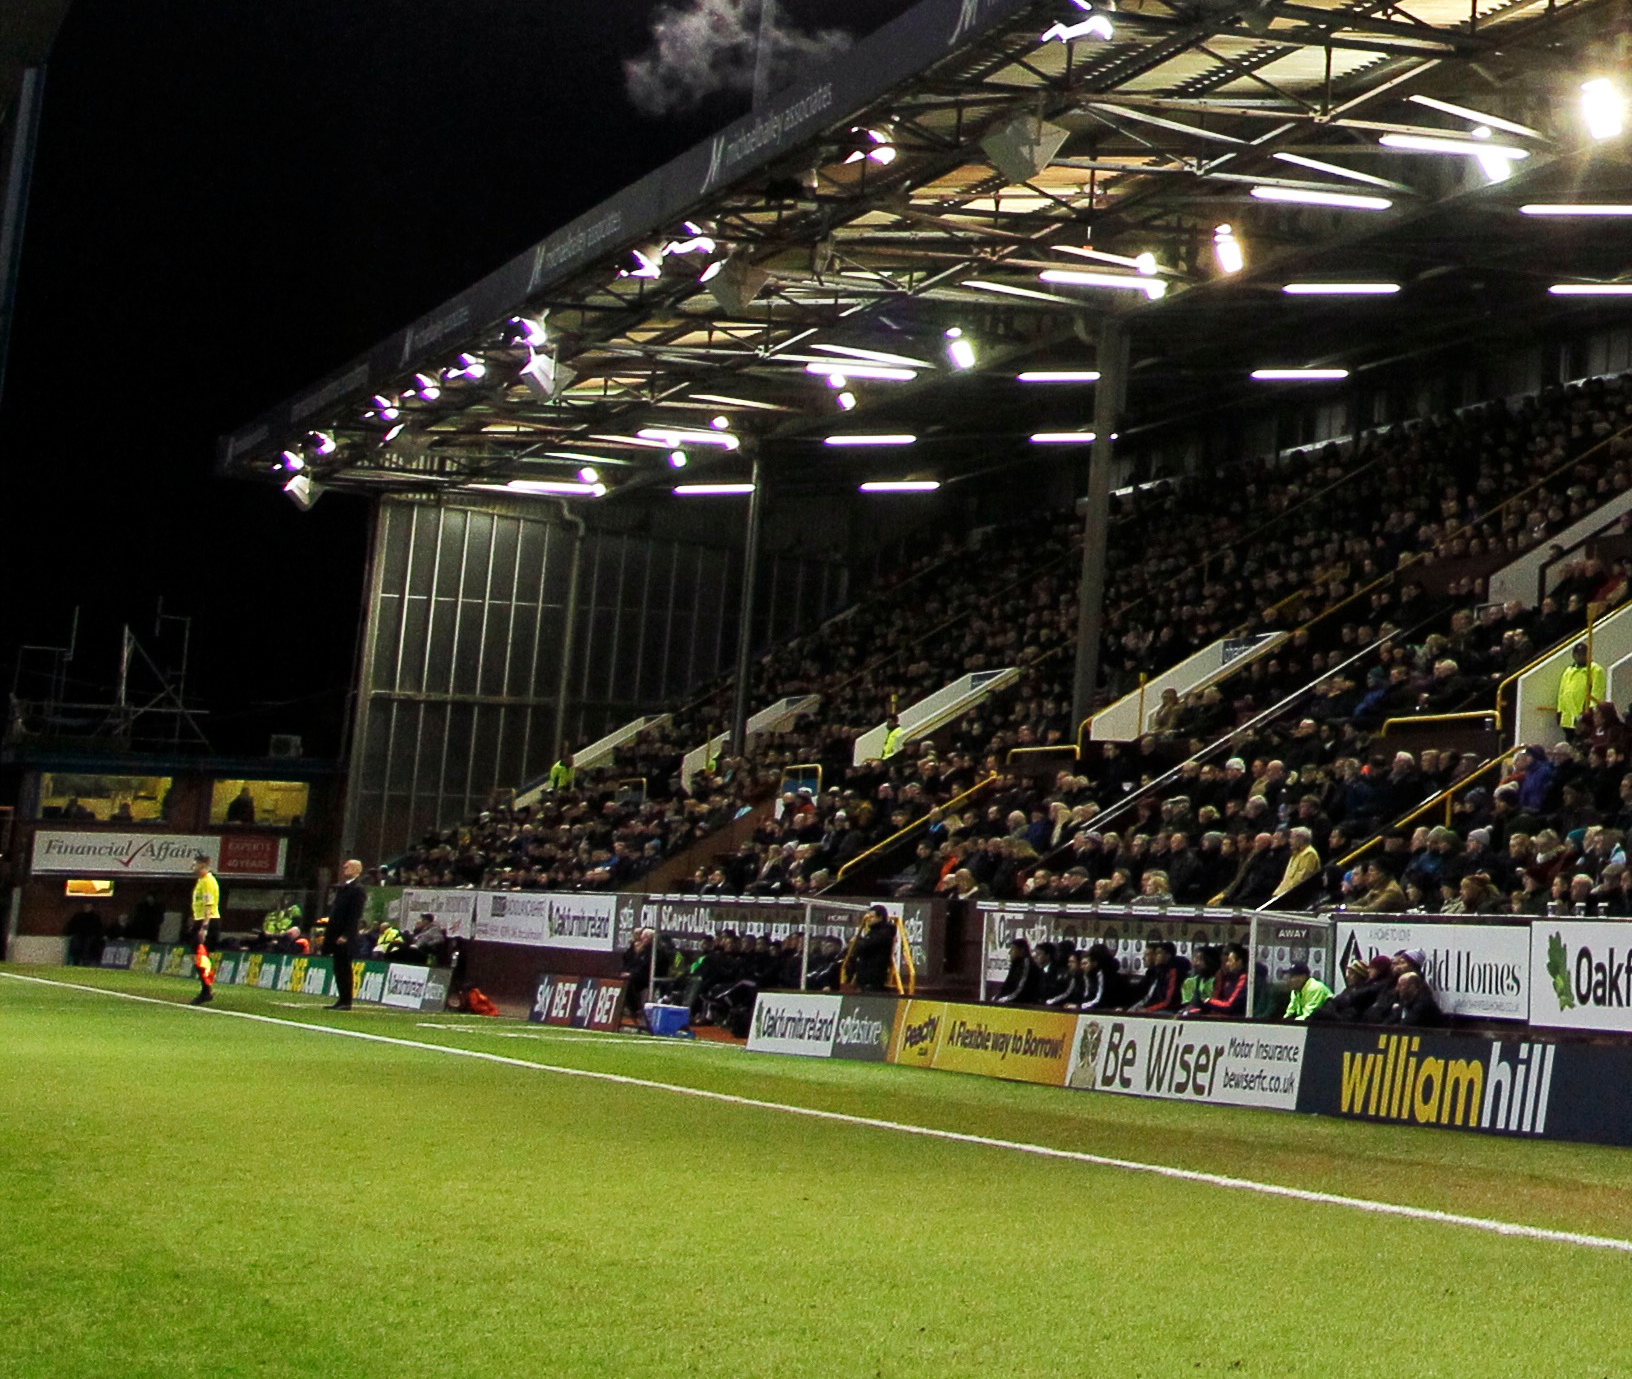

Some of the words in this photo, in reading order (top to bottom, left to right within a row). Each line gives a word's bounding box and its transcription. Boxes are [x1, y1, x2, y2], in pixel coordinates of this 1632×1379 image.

[44, 838, 132, 858] Financial
[1277, 929, 1309, 938] AWAY
[1456, 950, 1522, 997] Homes
[534, 976, 554, 1021] sky
[552, 981, 577, 1018] BET
[576, 980, 597, 1027] sky
[594, 986, 622, 1024] BET
[947, 1020, 957, 1046] A
[957, 1020, 991, 1050] Flexible
[991, 1032, 1012, 1060] way
[1011, 1029, 1023, 1054] to
[1022, 1028, 1067, 1059] Borrow!
[1101, 1022, 1137, 1088] Be
[1144, 1023, 1225, 1097] Wiser
[1228, 1037, 1254, 1058] Motor
[1254, 1038, 1299, 1062] Insurance
